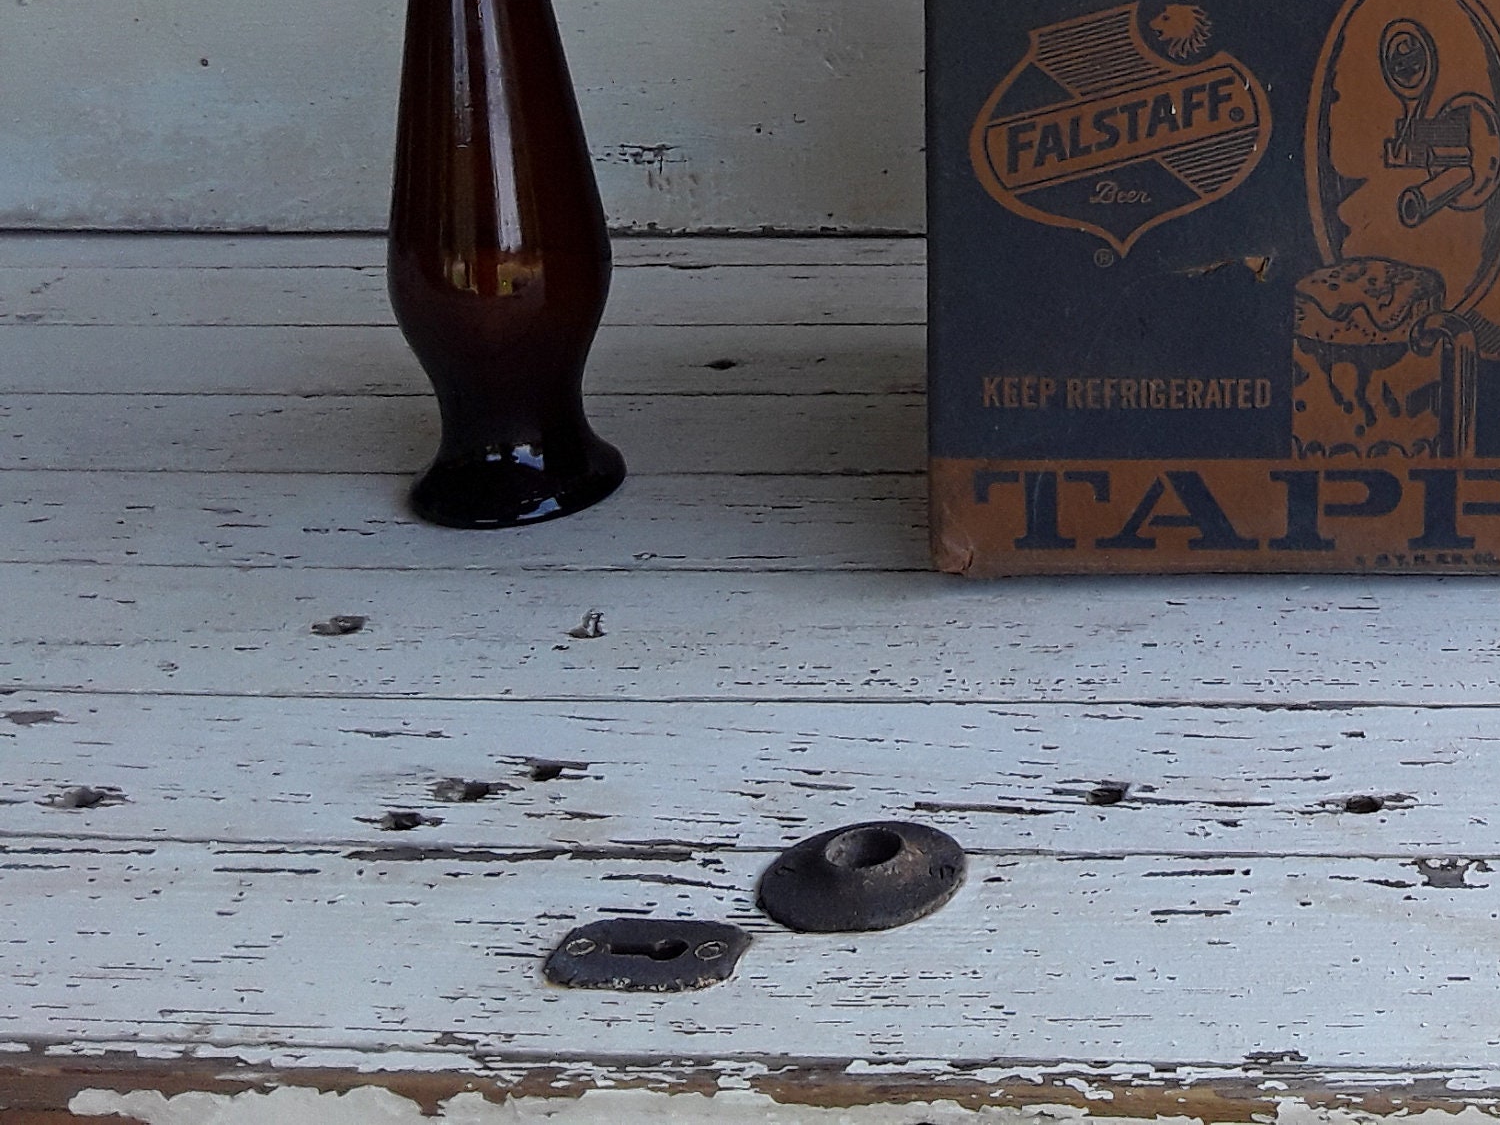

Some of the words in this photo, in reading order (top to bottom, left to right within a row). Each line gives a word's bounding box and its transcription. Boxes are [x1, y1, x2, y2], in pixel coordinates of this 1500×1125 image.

[1005, 76, 1236, 175] FALSTAFF
[1089, 180, 1151, 204] Beer
[982, 377, 1056, 408] KEEP
[1066, 378, 1272, 409] REFRIGERATED
